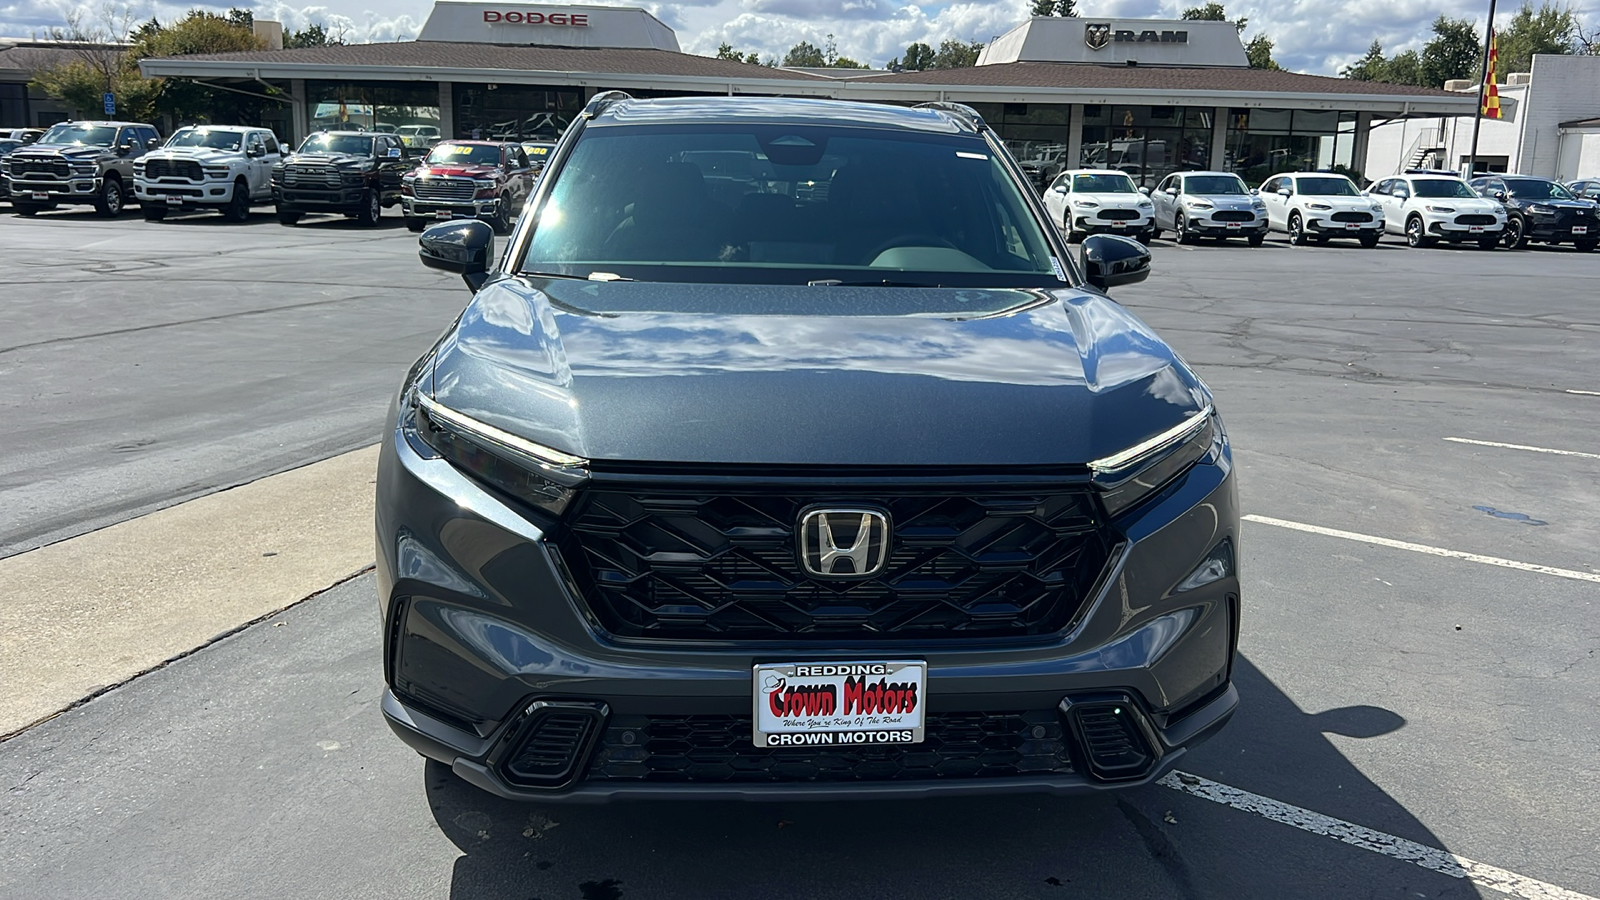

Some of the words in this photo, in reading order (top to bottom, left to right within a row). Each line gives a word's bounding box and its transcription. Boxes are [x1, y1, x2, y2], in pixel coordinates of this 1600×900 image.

[483, 11, 588, 27] DODGE
[1114, 30, 1188, 43] RAM
[796, 665, 885, 676] REDDING
[769, 678, 837, 718] Crown
[844, 676, 917, 716] Motors
[783, 719, 805, 727] Where
[807, 718, 831, 729] You're
[833, 718, 851, 727] King
[854, 717, 864, 726] Of
[866, 716, 879, 724] The
[882, 716, 903, 724] Road
[767, 733, 833, 745] CROWN
[838, 731, 913, 743] MOTORS
